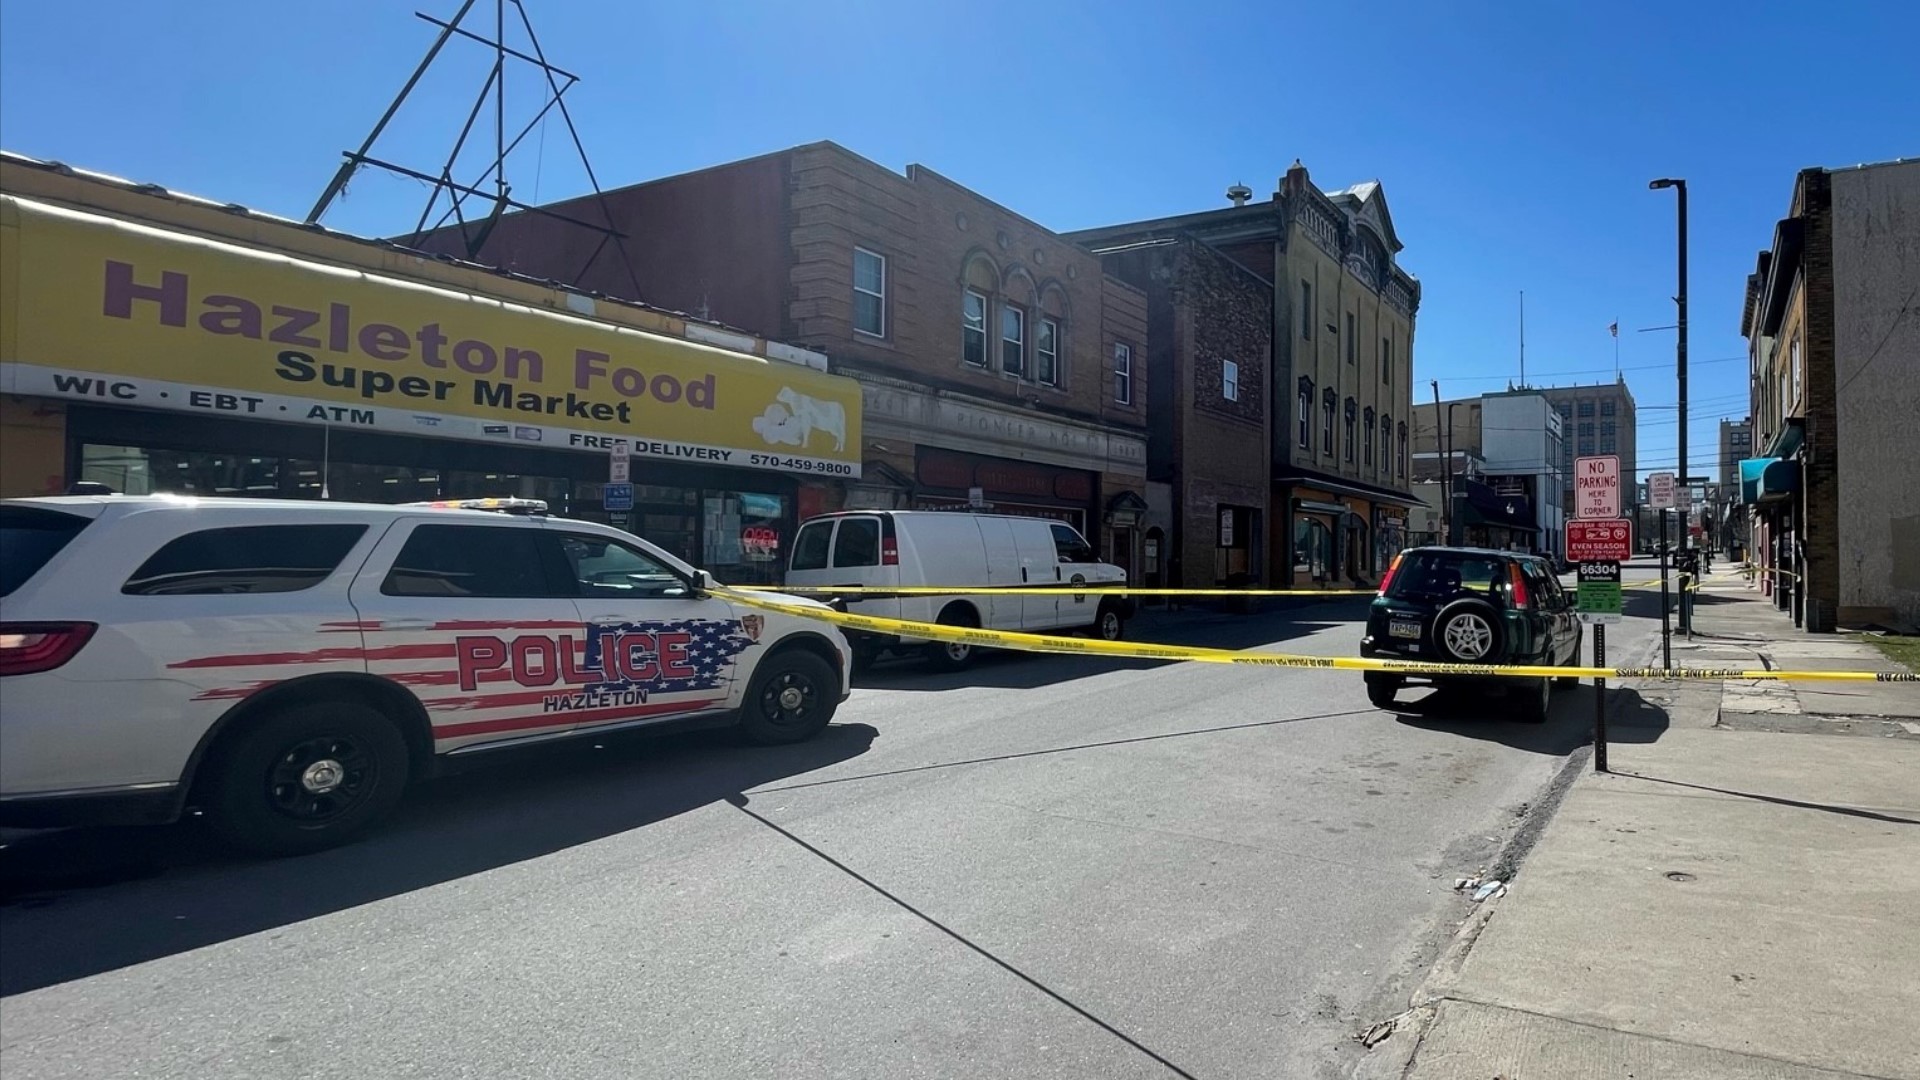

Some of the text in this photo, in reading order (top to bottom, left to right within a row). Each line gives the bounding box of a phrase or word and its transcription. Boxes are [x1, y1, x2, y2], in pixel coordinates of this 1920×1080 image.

[103, 259, 716, 410] Hazleton Food
[275, 351, 631, 424] Super Market
[53, 374, 375, 425] WIC EBT ATM
[569, 433, 732, 462] FRE DELIVERY
[750, 454, 852, 475] 570-459-9800
[1589, 462, 1605, 474] NO
[1579, 475, 1616, 489] PARKING
[1588, 490, 1607, 498] HERE
[1594, 498, 1602, 506] TO
[1584, 506, 1612, 515] CORNER
[1572, 542, 1592, 550] EVEN
[1580, 564, 1617, 574] 66304
[455, 632, 697, 691] POLICE
[543, 690, 649, 713] HAZLETON
